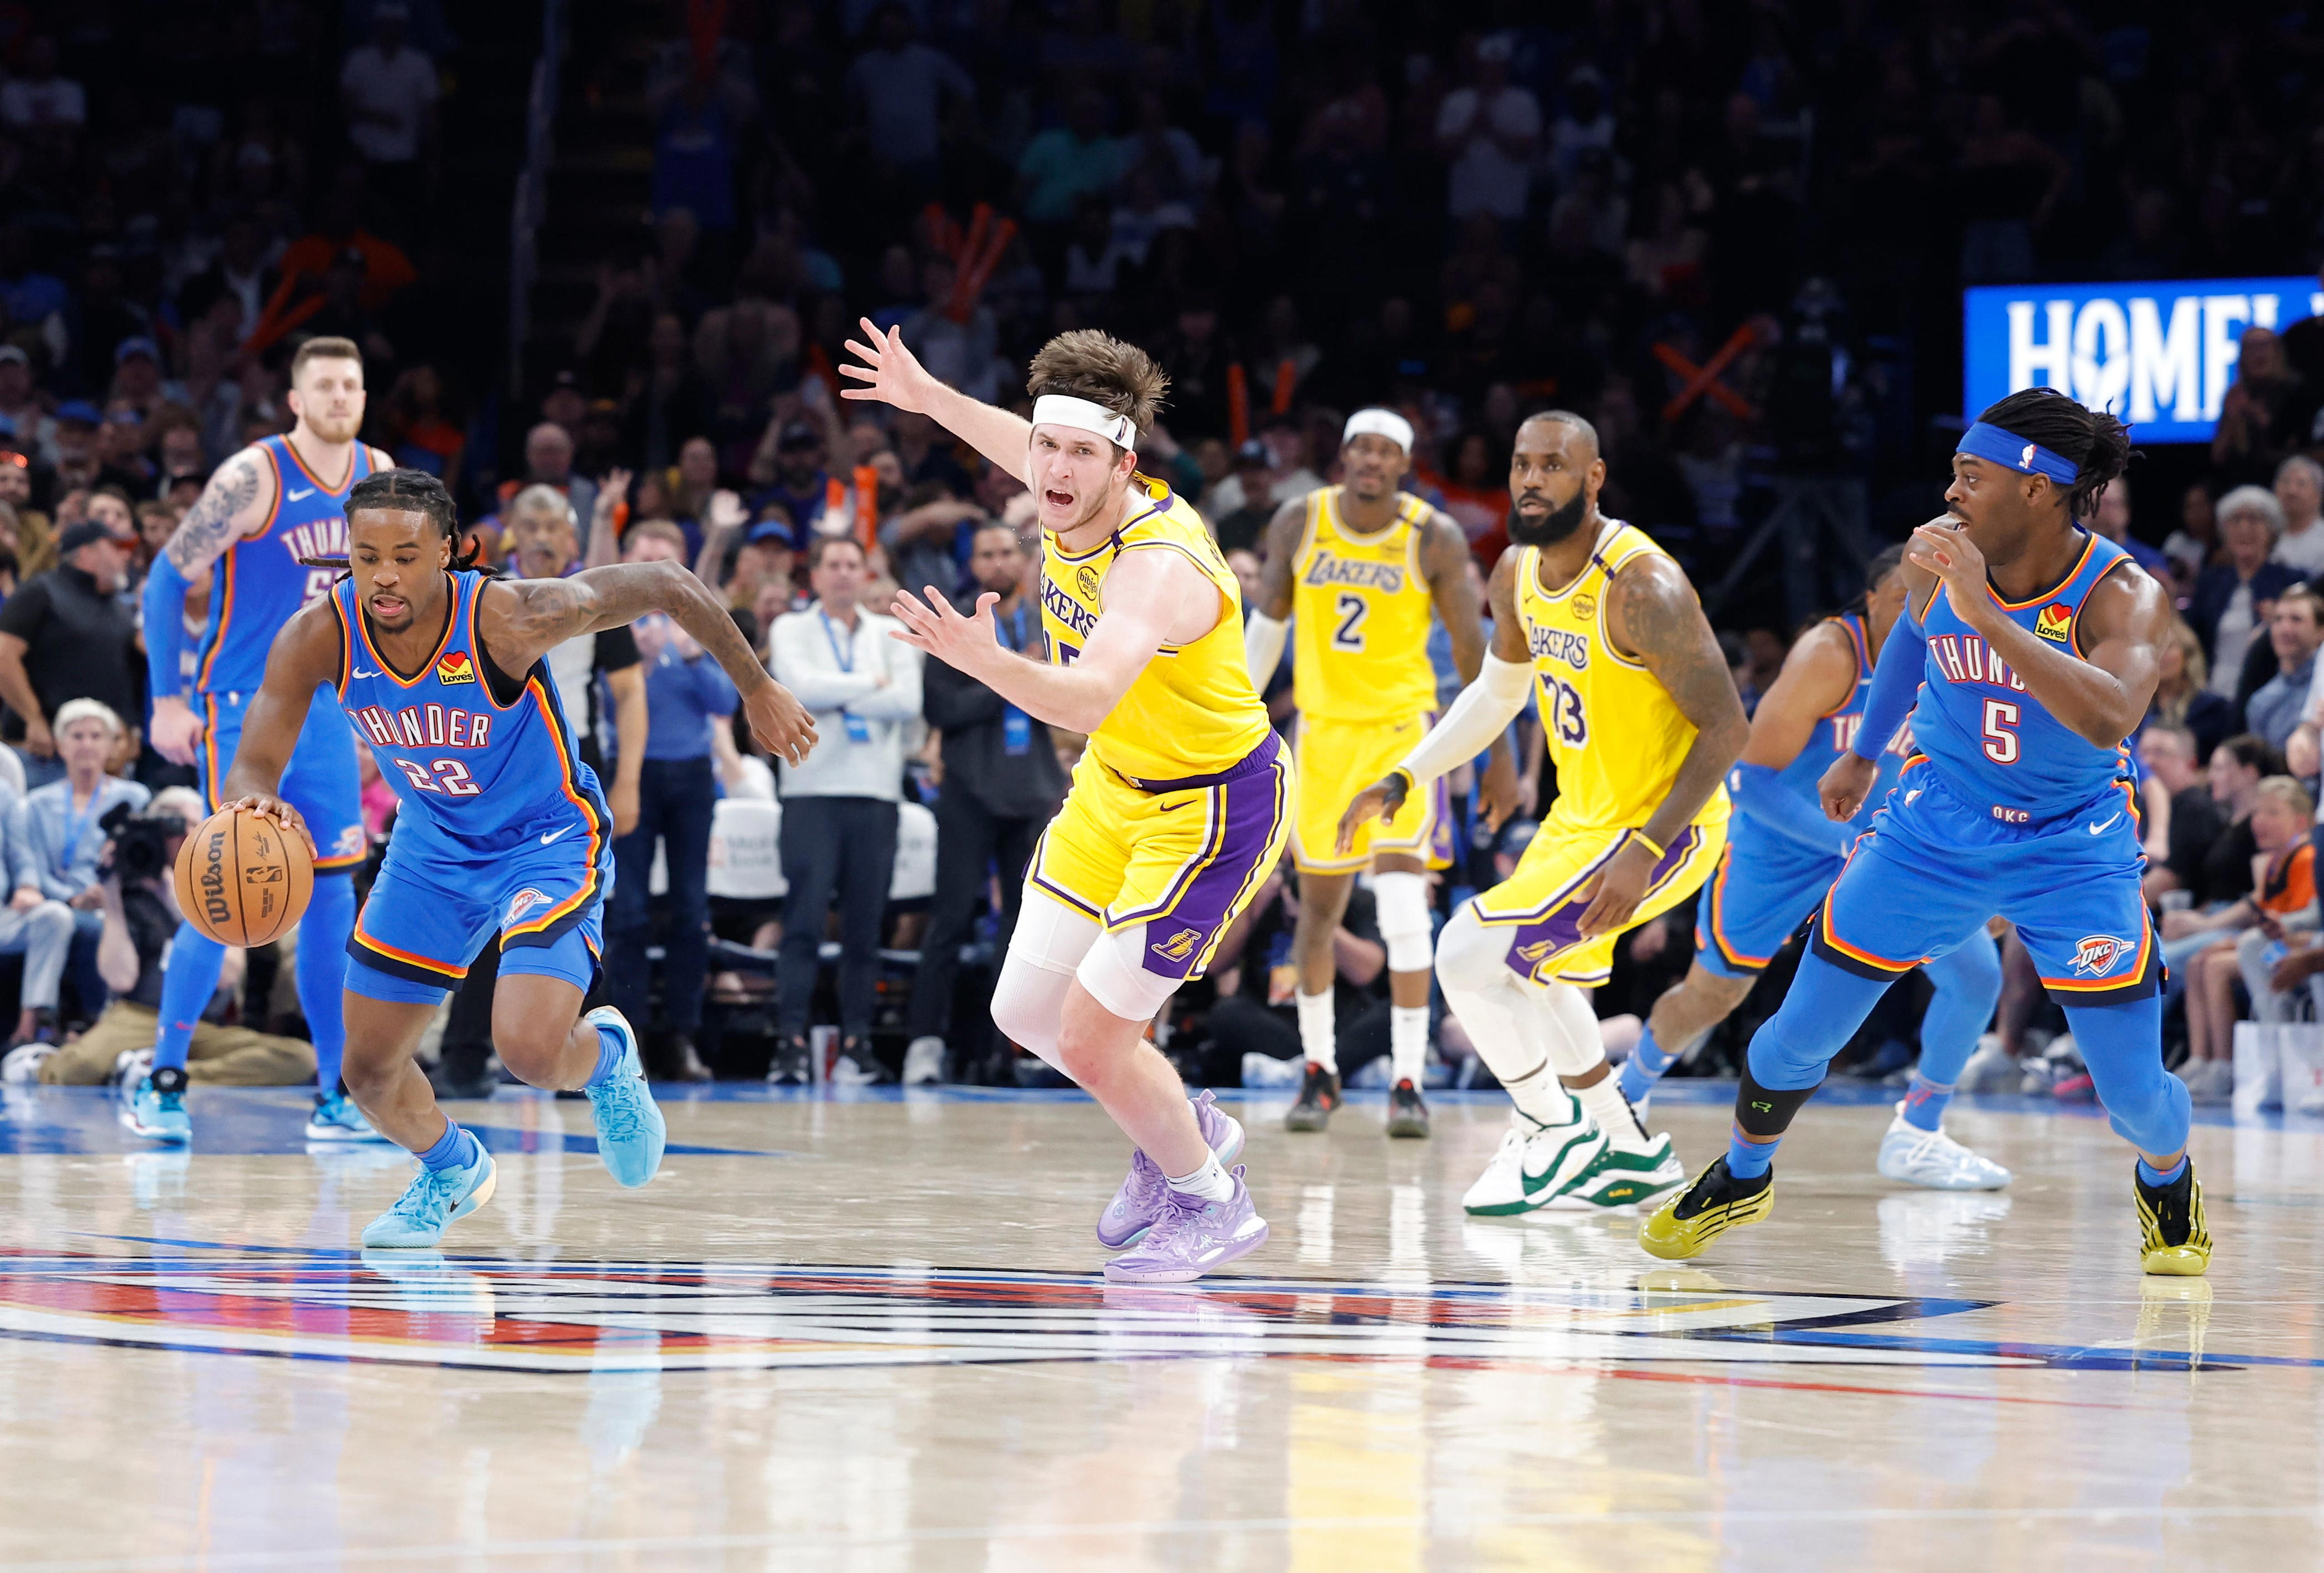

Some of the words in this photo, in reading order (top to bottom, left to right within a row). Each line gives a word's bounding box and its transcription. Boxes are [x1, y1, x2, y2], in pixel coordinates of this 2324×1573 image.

[1333, 593, 1367, 652] 2
[1929, 635, 2029, 693] THUN
[344, 704, 492, 748] THUNDER
[1983, 698, 2019, 765] 5
[393, 758, 483, 797] 22
[1992, 805, 2030, 823] OKC
[200, 830, 231, 925] Wilson
[2078, 942, 2112, 970] OKC
